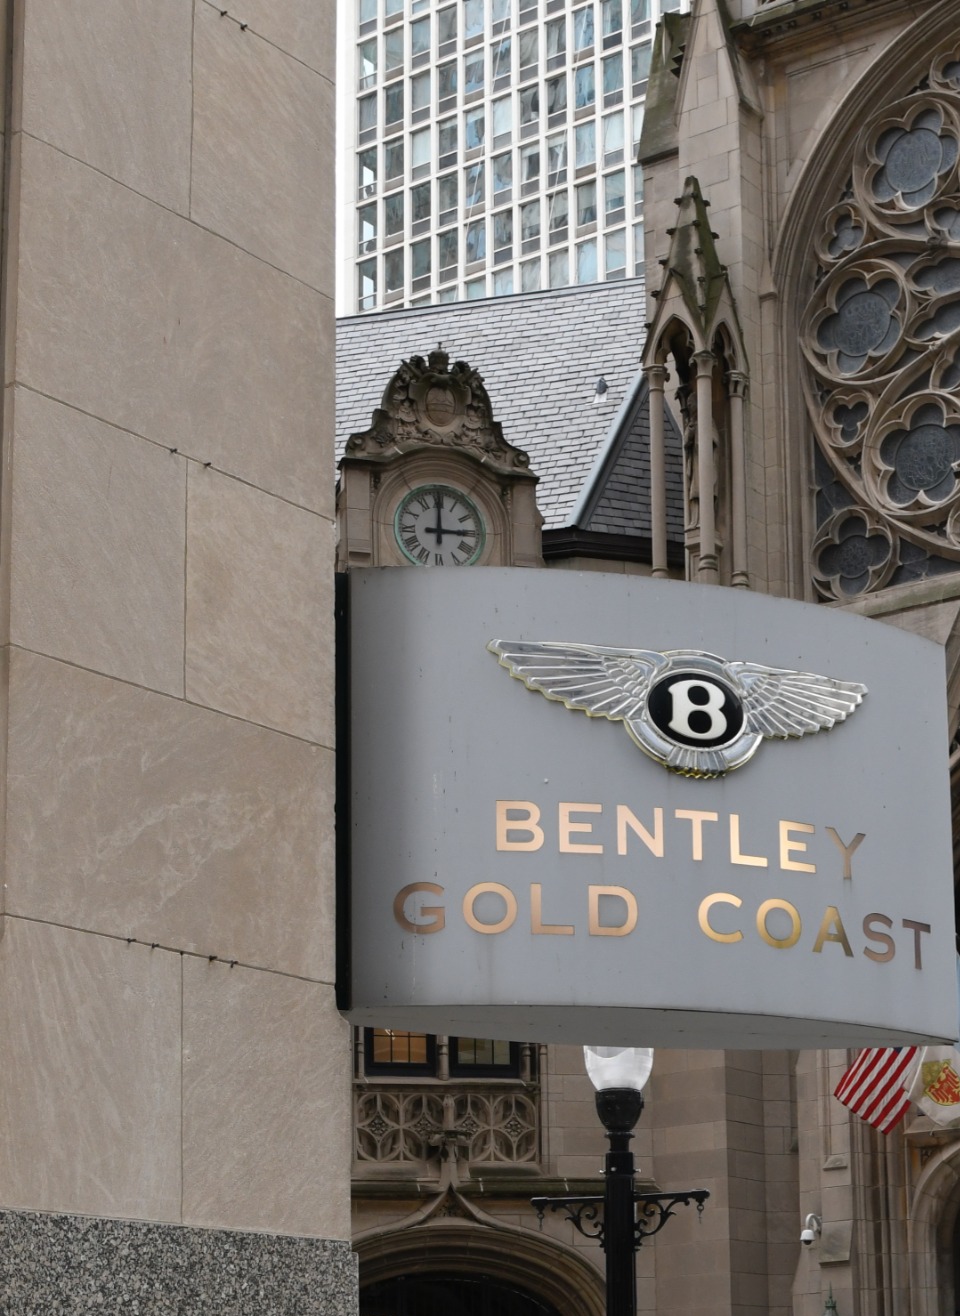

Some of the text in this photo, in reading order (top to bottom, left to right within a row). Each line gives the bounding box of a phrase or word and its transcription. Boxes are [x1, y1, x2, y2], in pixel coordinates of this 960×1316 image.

[667, 680, 727, 741] B
[495, 800, 866, 880] BENTLEY
[393, 882, 932, 970] GOLD COAST
